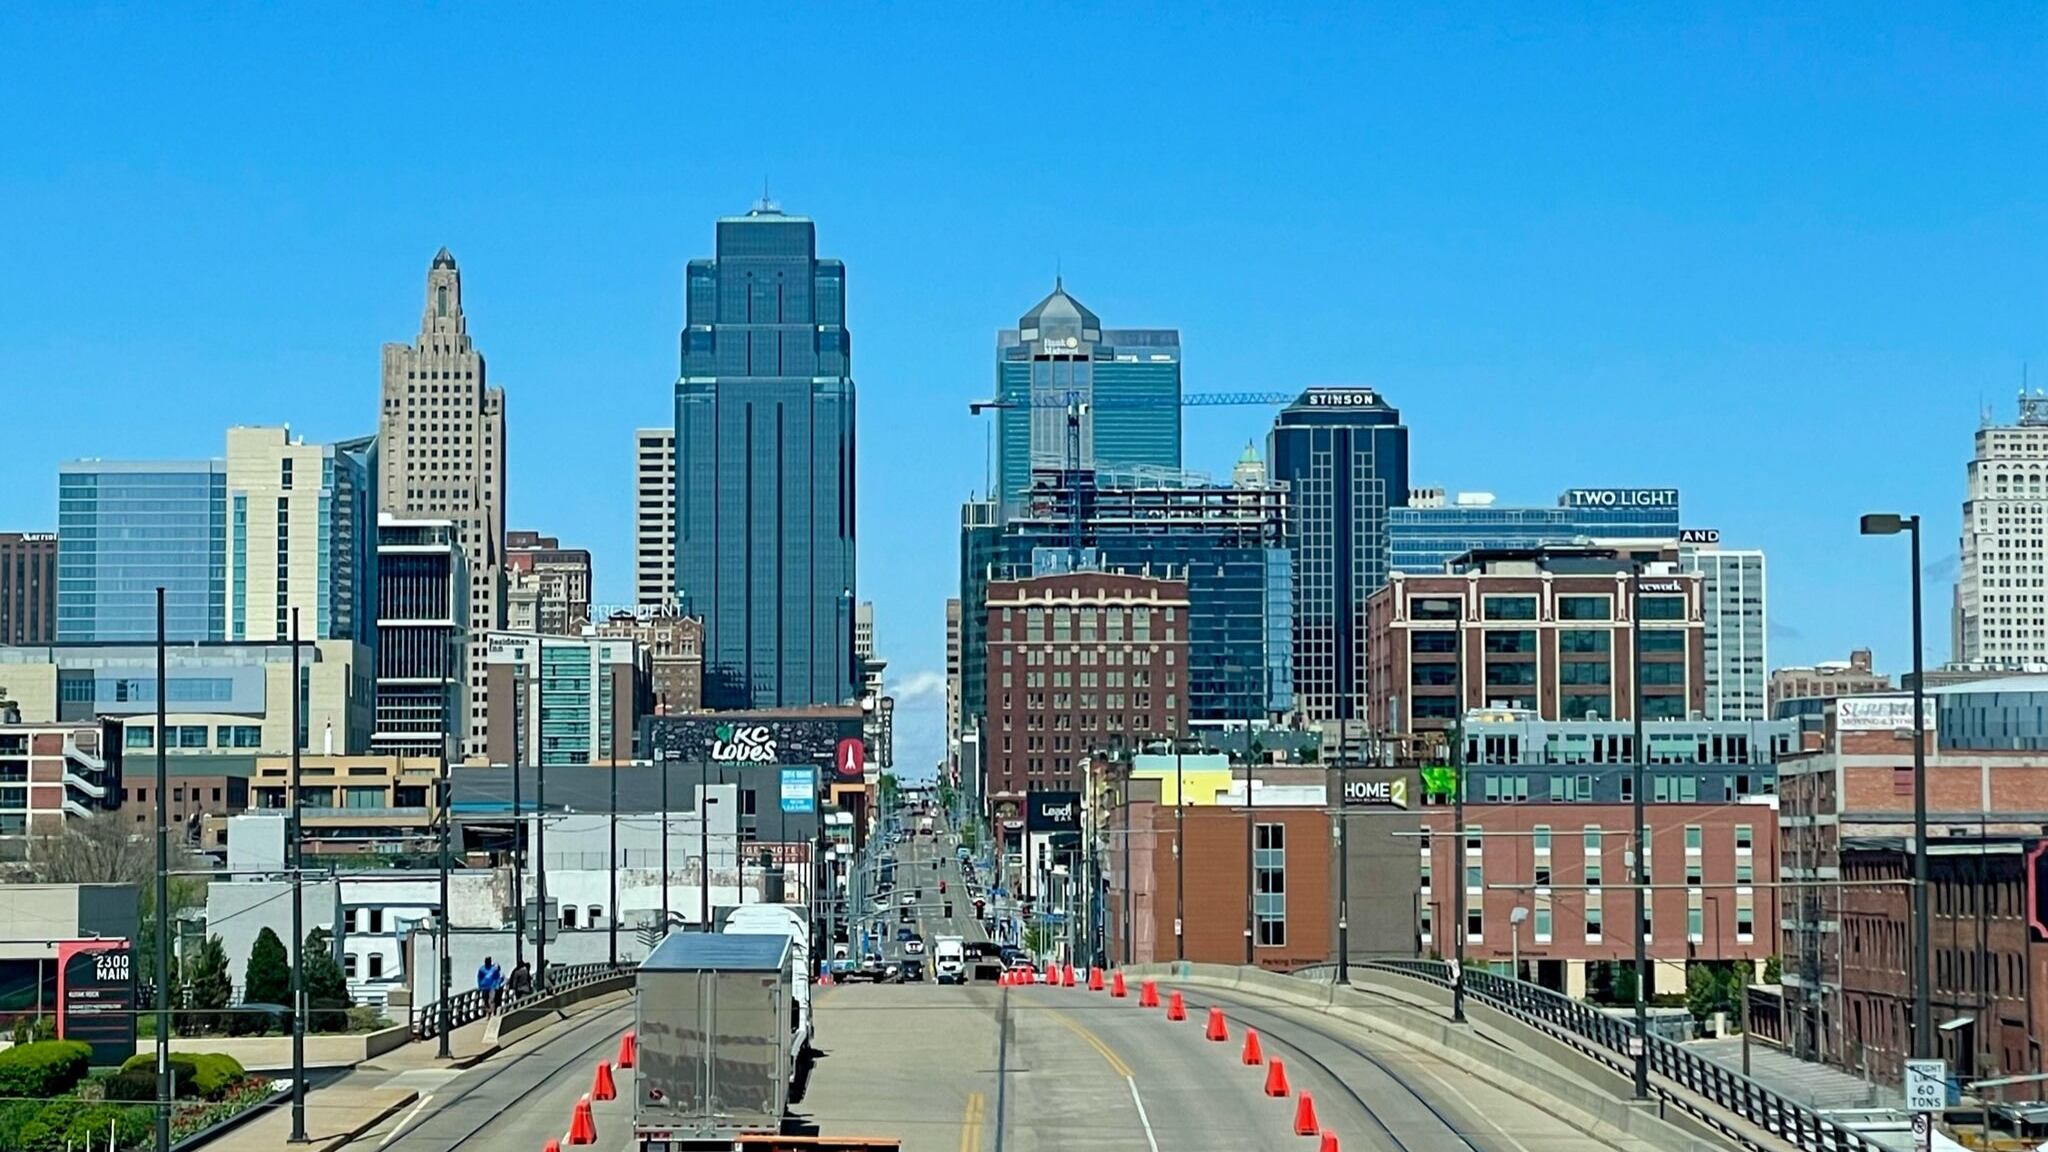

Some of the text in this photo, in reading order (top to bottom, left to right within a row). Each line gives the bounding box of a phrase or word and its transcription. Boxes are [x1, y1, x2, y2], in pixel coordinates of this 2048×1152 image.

[1310, 395, 1373, 405] STINSON
[1573, 491, 1676, 505] TWO LIGHT
[20, 533, 57, 542] Marriot
[1682, 531, 1719, 542] AND
[586, 603, 683, 618] PRESIDENT
[489, 638, 530, 646] Residence
[733, 726, 770, 746] KC
[97, 955, 129, 968] 2300
[97, 968, 129, 980] MAIN
[1917, 1085, 1935, 1096] 60
[1911, 1097, 1941, 1108] TONS
